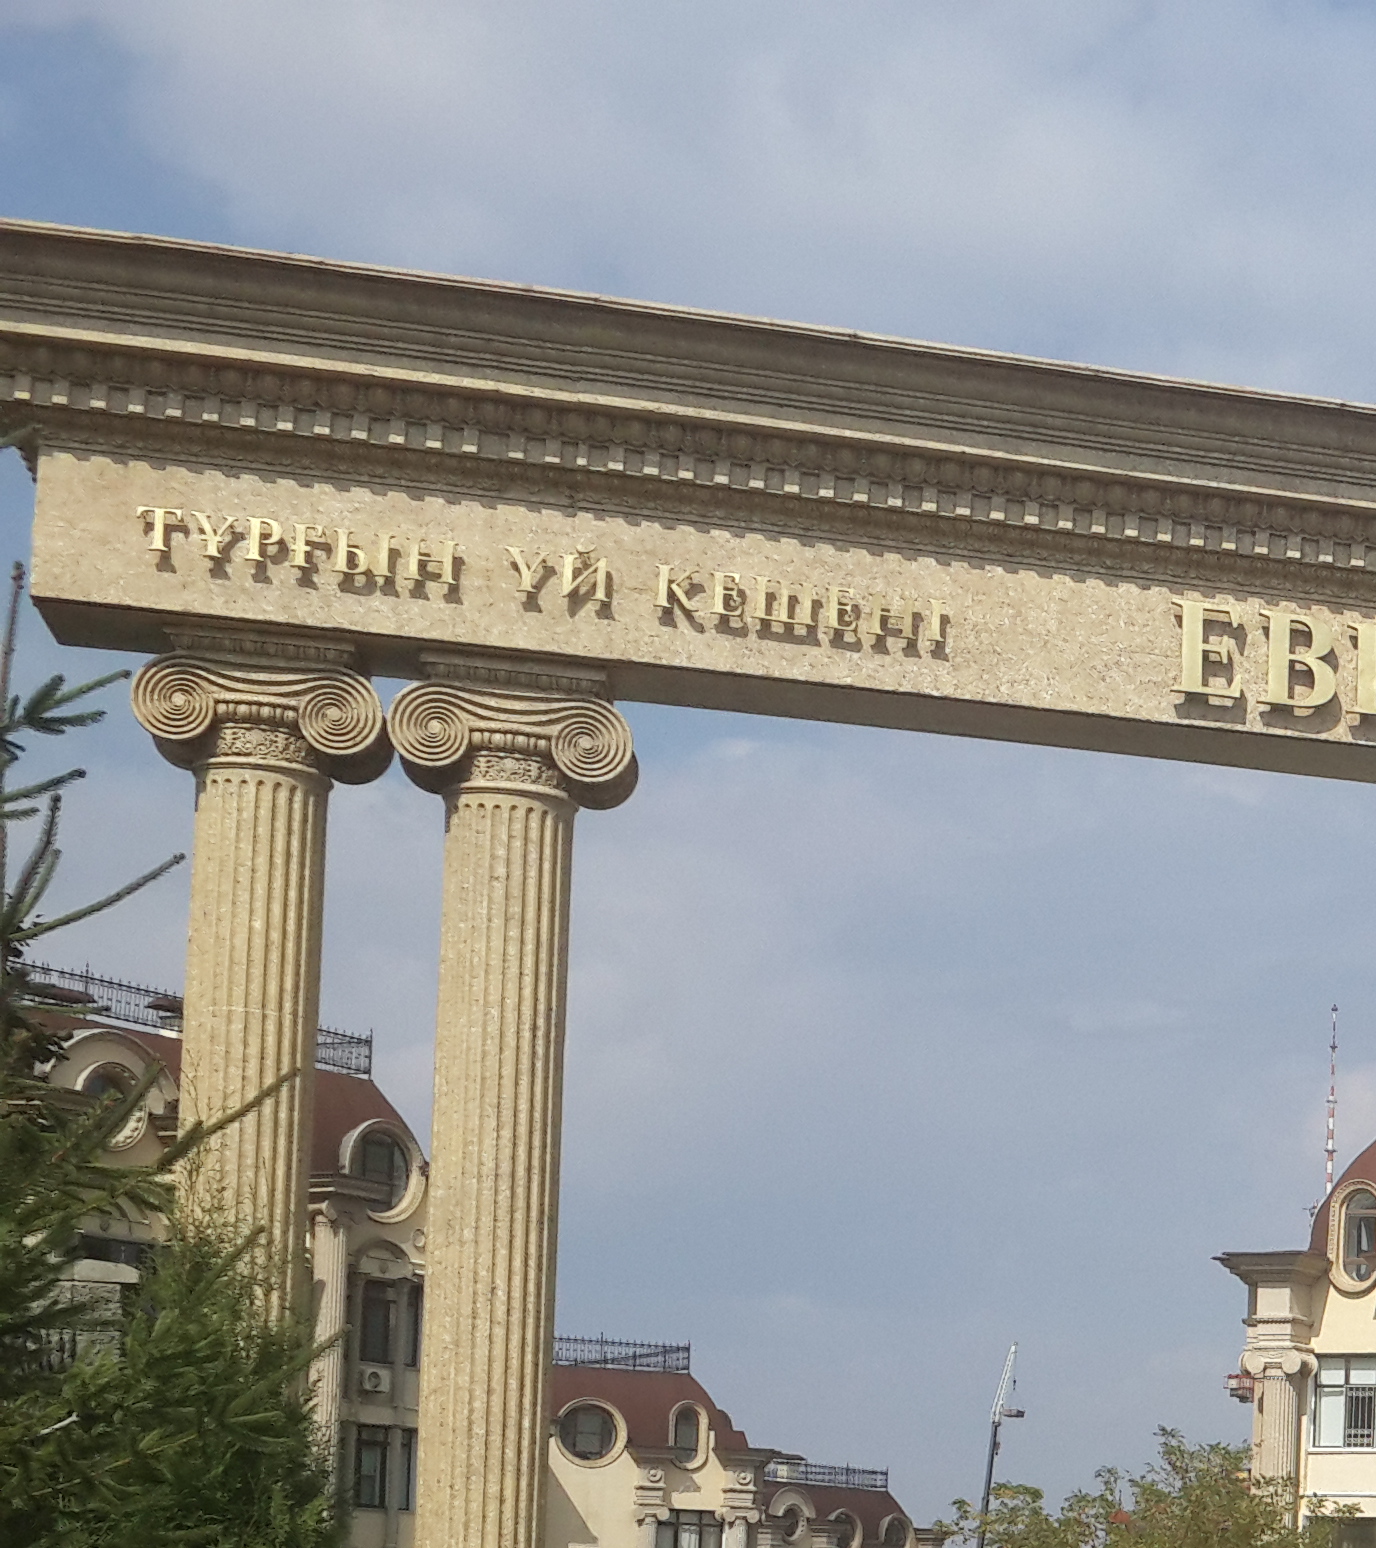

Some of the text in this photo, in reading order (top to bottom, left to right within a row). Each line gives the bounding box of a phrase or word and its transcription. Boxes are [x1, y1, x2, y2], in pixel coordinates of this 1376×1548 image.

[136, 505, 949, 642] ТҰРҒЫН ҮЙ КЕШЕНІ
